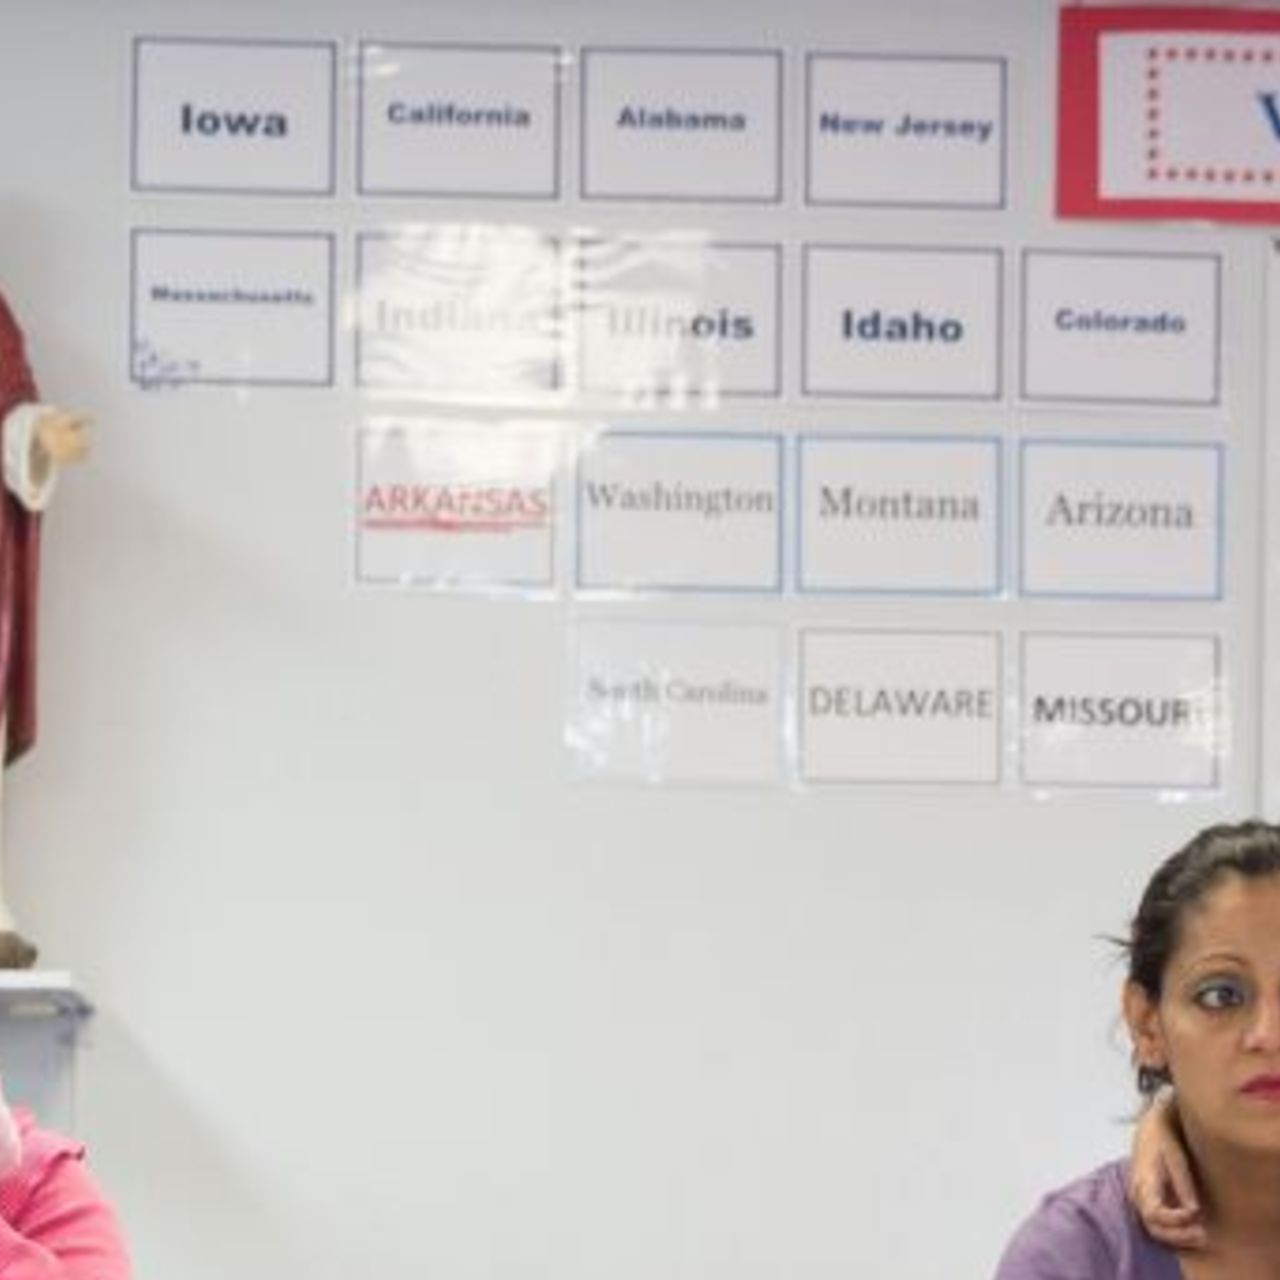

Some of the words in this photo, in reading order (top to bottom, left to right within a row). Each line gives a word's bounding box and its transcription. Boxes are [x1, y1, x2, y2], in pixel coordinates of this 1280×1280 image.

[180, 102, 289, 138] Iowa
[386, 101, 532, 130] California
[616, 106, 746, 131] Alabama
[819, 113, 885, 137] New
[894, 114, 994, 142] Jersey
[608, 305, 756, 341] Illinois
[841, 309, 965, 343] Idaho
[1055, 307, 1188, 334] Colorado
[364, 482, 548, 518] ARKANSAS
[585, 482, 774, 520] Washington
[820, 485, 980, 521] Montana
[1046, 492, 1195, 528] Arizona
[809, 688, 993, 719] DELAWARE
[1033, 695, 1204, 727] MISSOUR
